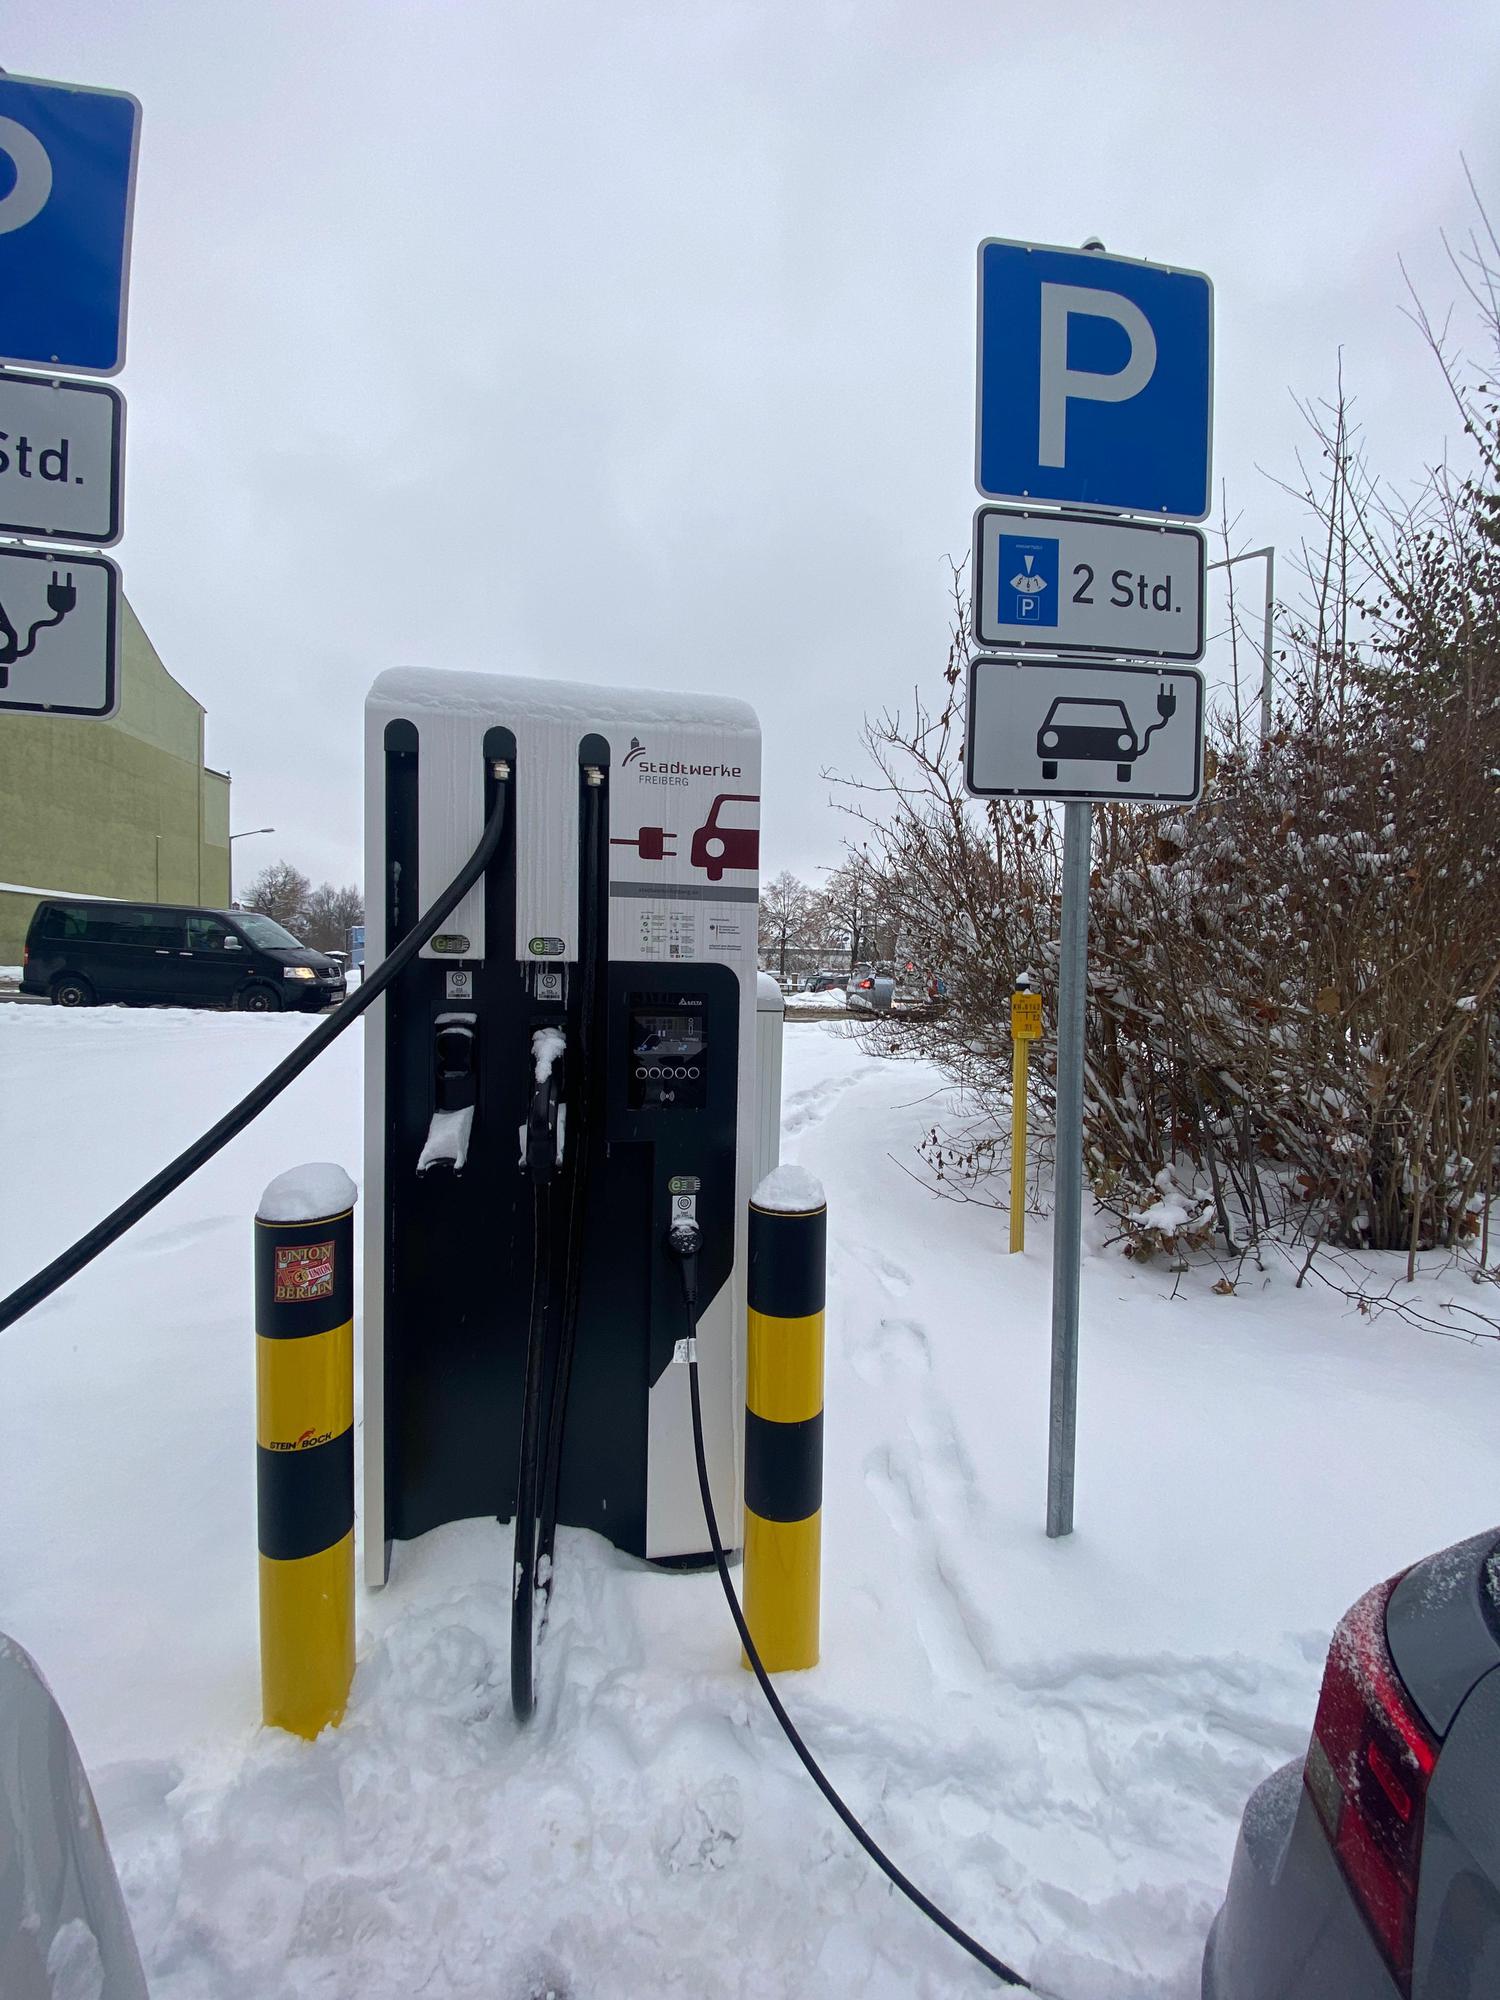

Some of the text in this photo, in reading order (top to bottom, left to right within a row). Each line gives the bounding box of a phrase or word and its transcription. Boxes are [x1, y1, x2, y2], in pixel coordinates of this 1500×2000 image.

[1039, 281, 1157, 468] P
[0, 431, 83, 485] td.
[1073, 563, 1181, 612] 2 Std.
[1022, 598, 1035, 617] P
[639, 775, 689, 786] FREIBERG
[278, 1245, 332, 1263] UNION
[308, 1264, 331, 1279] UNION
[276, 1279, 332, 1299] BERLIN
[270, 1431, 333, 1450] STEIN BOCK
